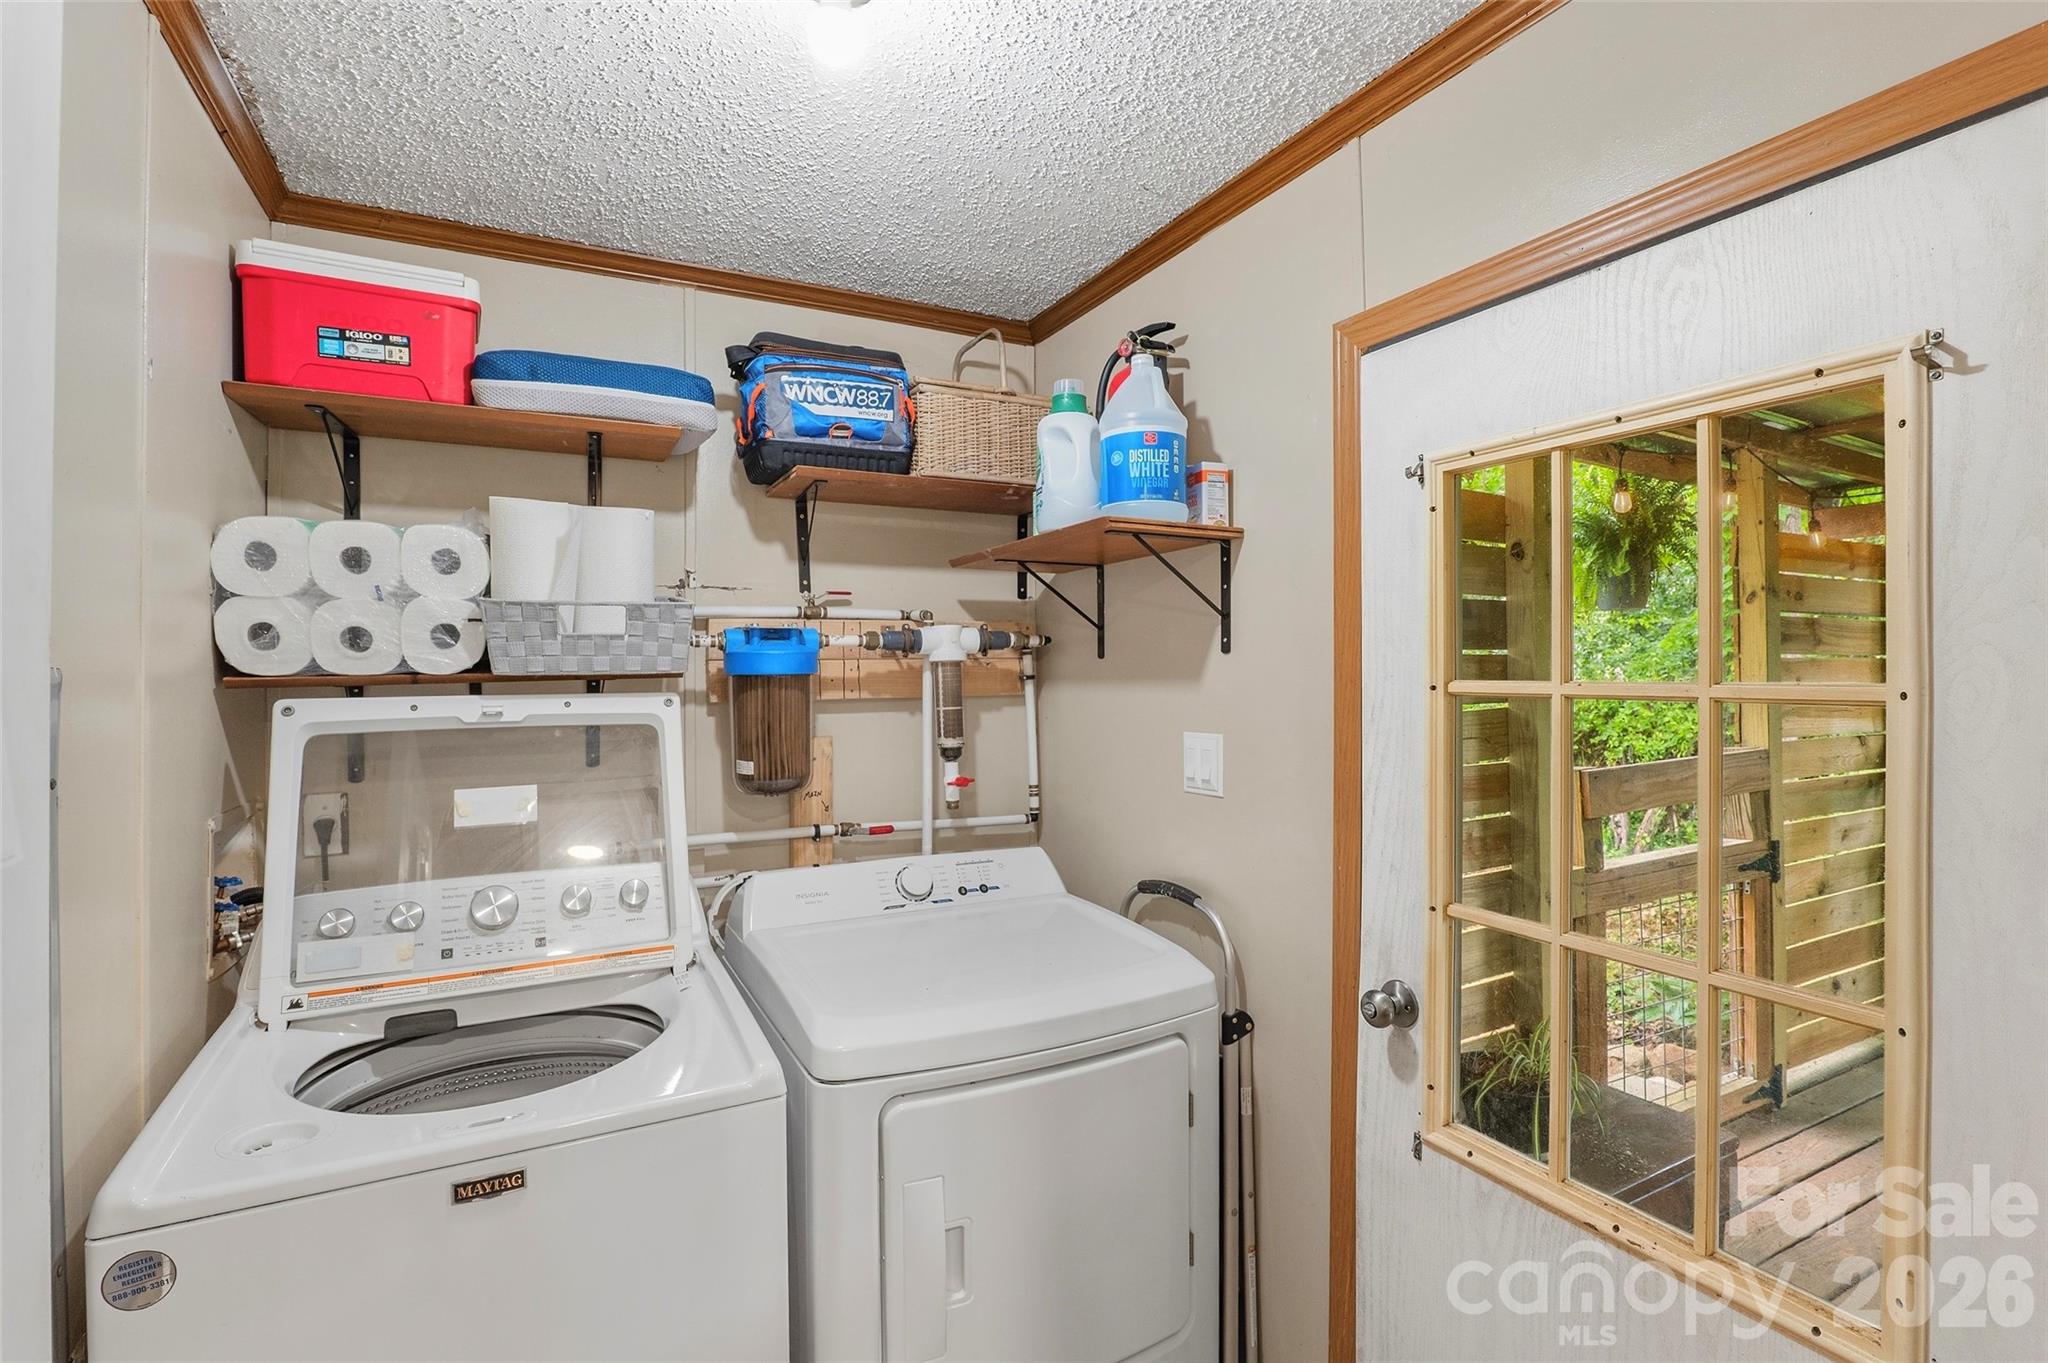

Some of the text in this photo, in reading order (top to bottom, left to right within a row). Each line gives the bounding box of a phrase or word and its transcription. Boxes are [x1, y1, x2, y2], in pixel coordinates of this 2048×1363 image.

[345, 330, 383, 340] IGLOO
[783, 383, 892, 408] WNCW 88.7
[858, 410, 889, 419] wncw.org
[1129, 448, 1170, 463] DISTILLED
[1129, 462, 1170, 478] WHITE
[456, 1174, 523, 1200] MAYTAG
[112, 1261, 163, 1282] ENREGISTRER
[118, 1256, 154, 1272] REGISTER
[121, 1271, 157, 1287] REGISTRE
